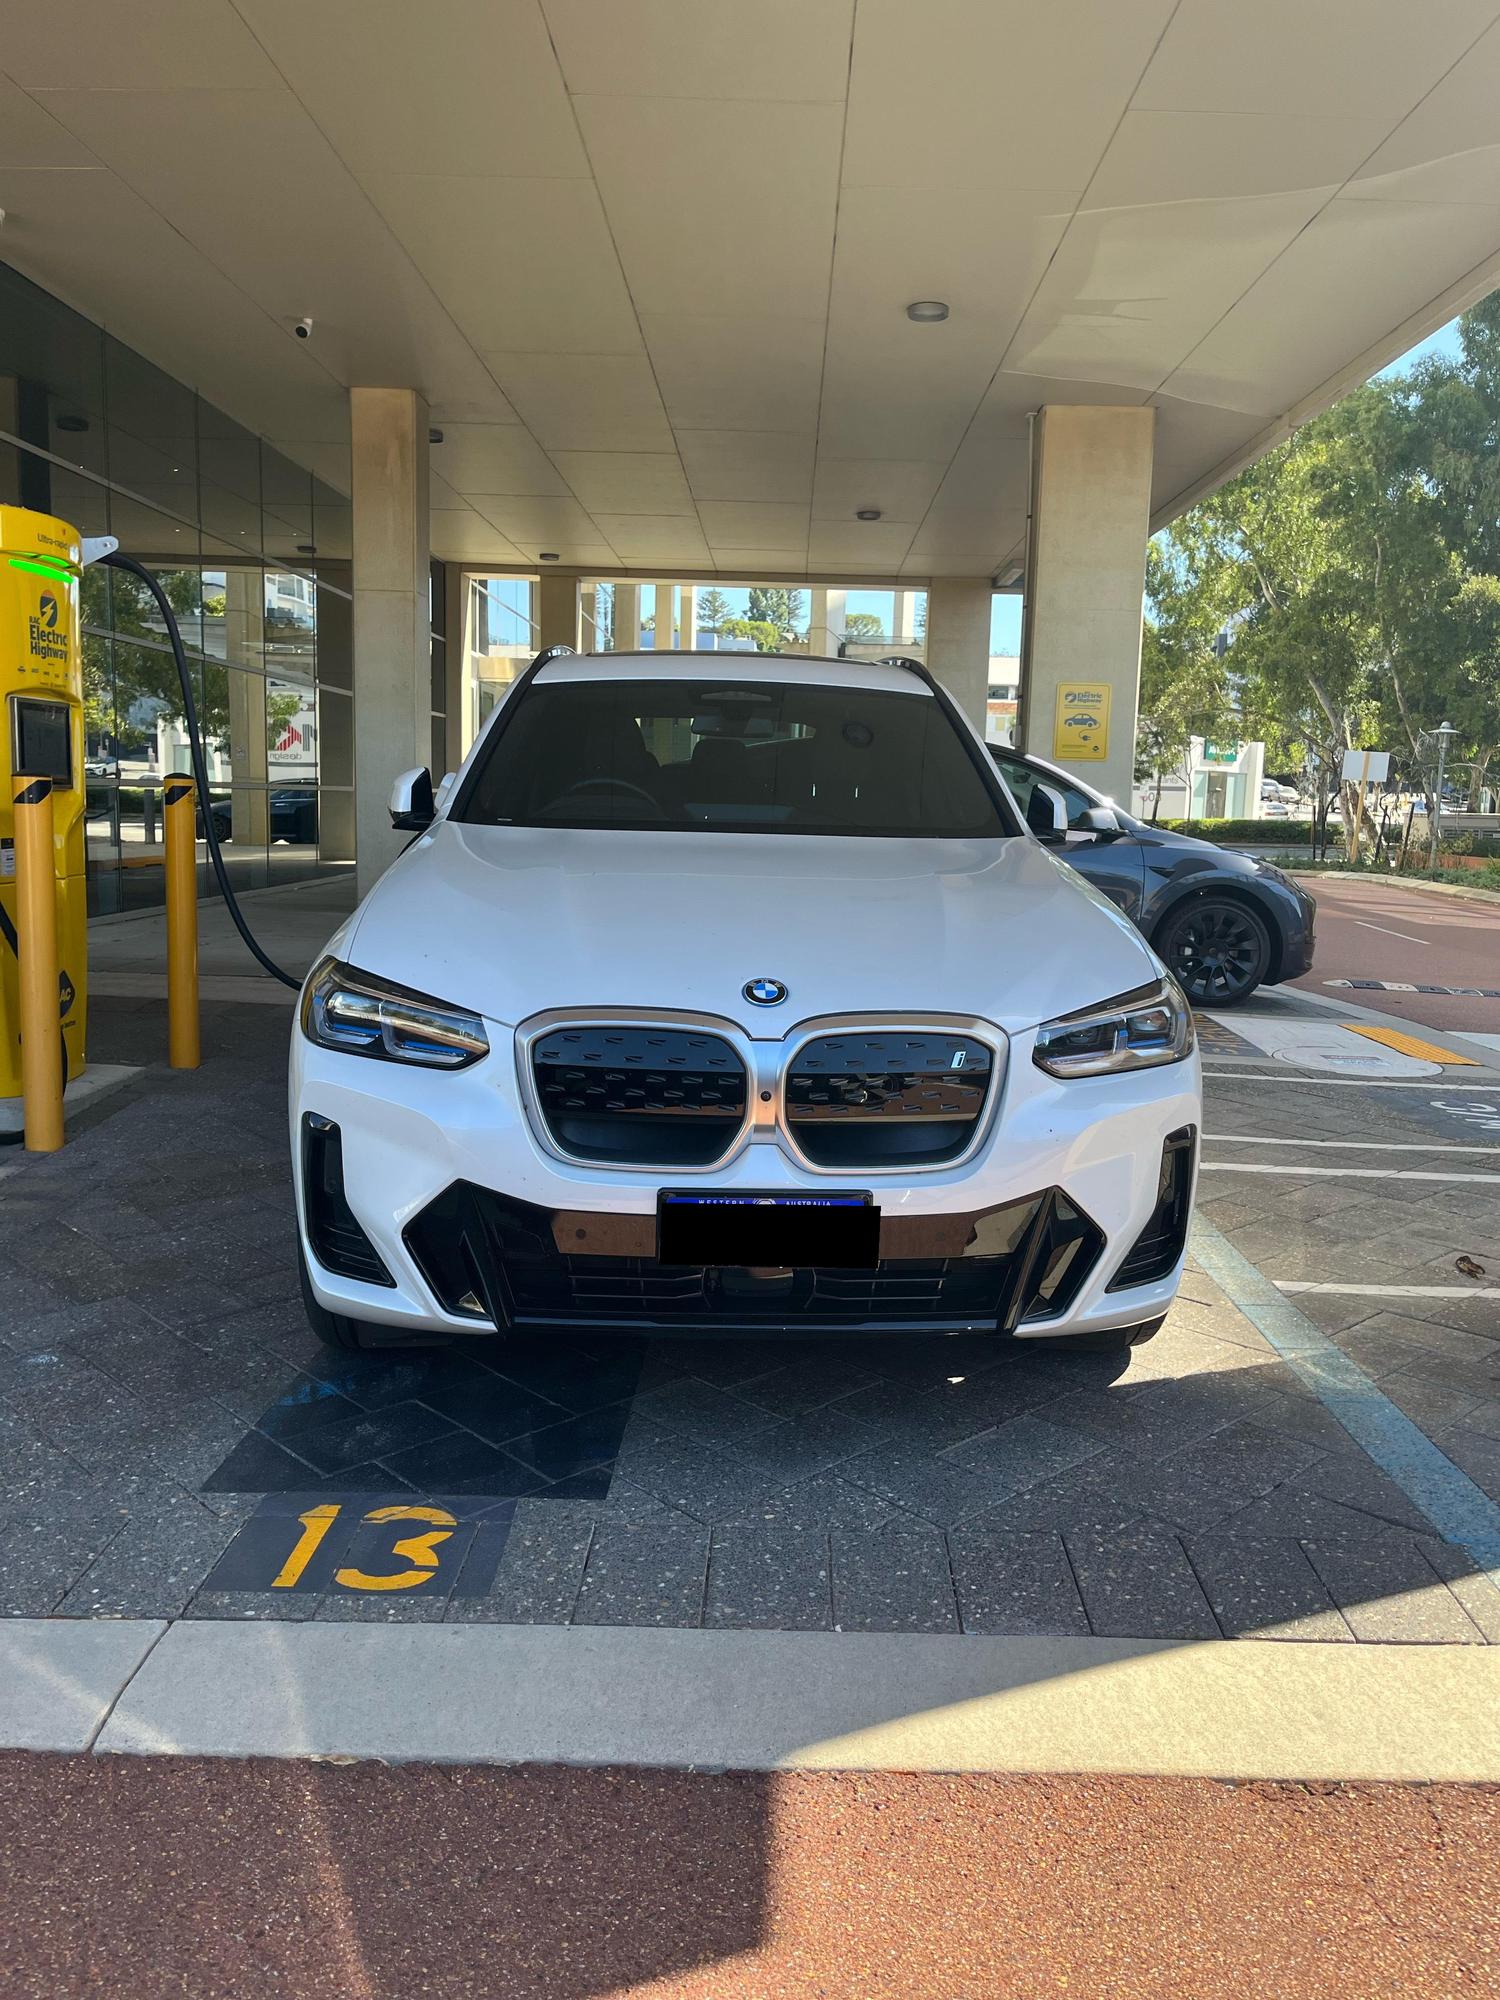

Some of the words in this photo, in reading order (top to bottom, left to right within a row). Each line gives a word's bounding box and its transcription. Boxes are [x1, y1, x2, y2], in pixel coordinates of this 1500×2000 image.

[29, 624, 68, 646] Electric
[30, 641, 68, 663] Highway
[271, 1504, 458, 1590] 13
